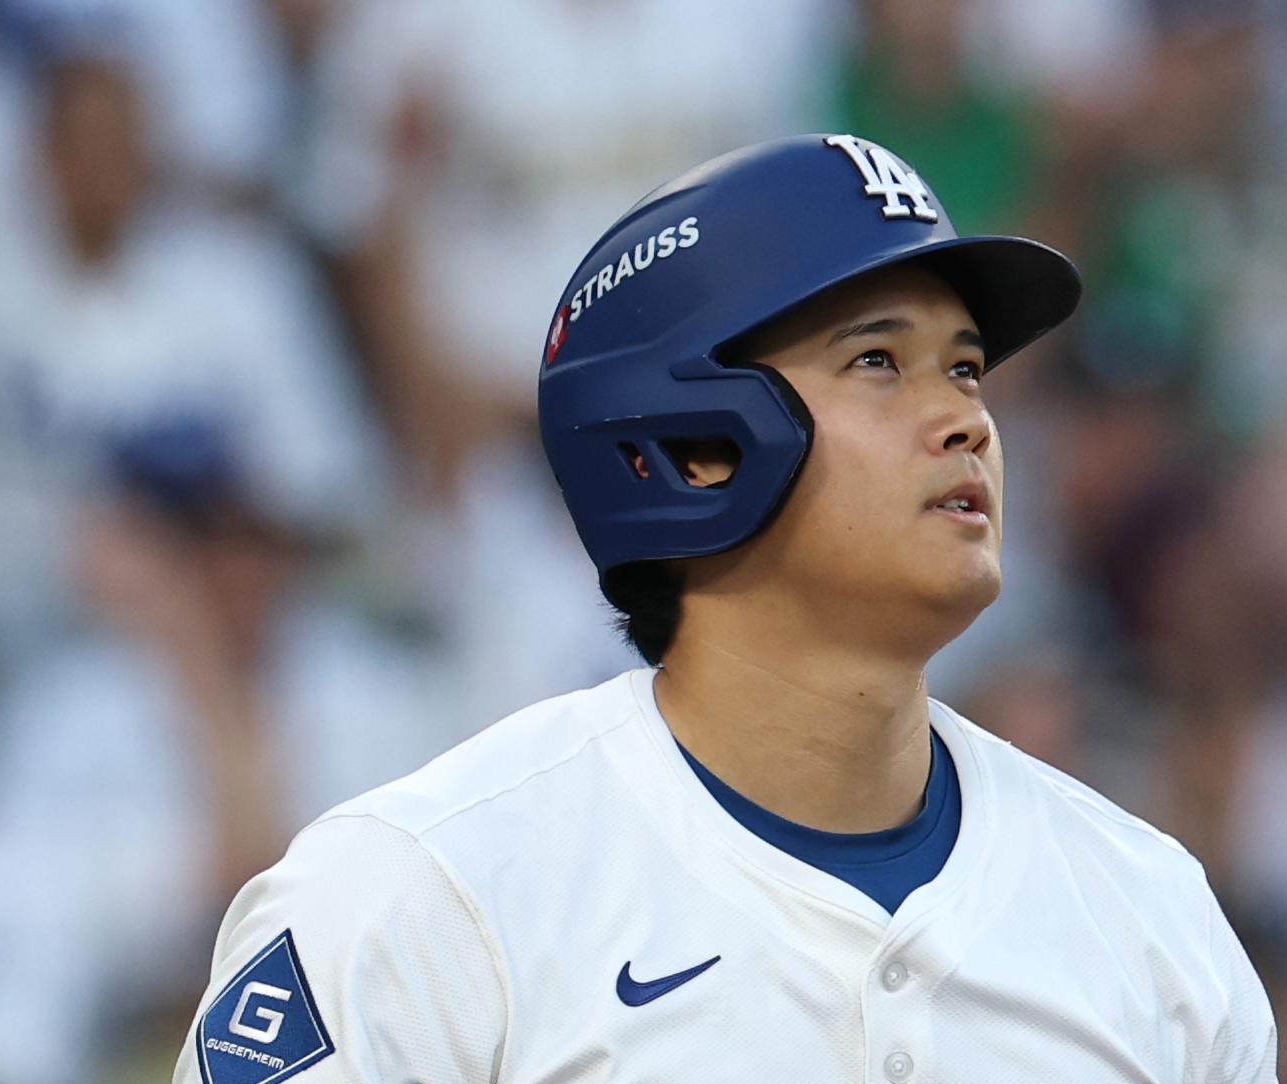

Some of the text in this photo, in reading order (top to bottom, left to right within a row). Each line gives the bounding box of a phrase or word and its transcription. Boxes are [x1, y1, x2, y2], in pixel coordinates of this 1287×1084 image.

[826, 134, 938, 219] LA
[569, 216, 700, 323] STRAUSS
[228, 981, 293, 1044] G
[206, 1038, 285, 1070] GUGGENHEIM
